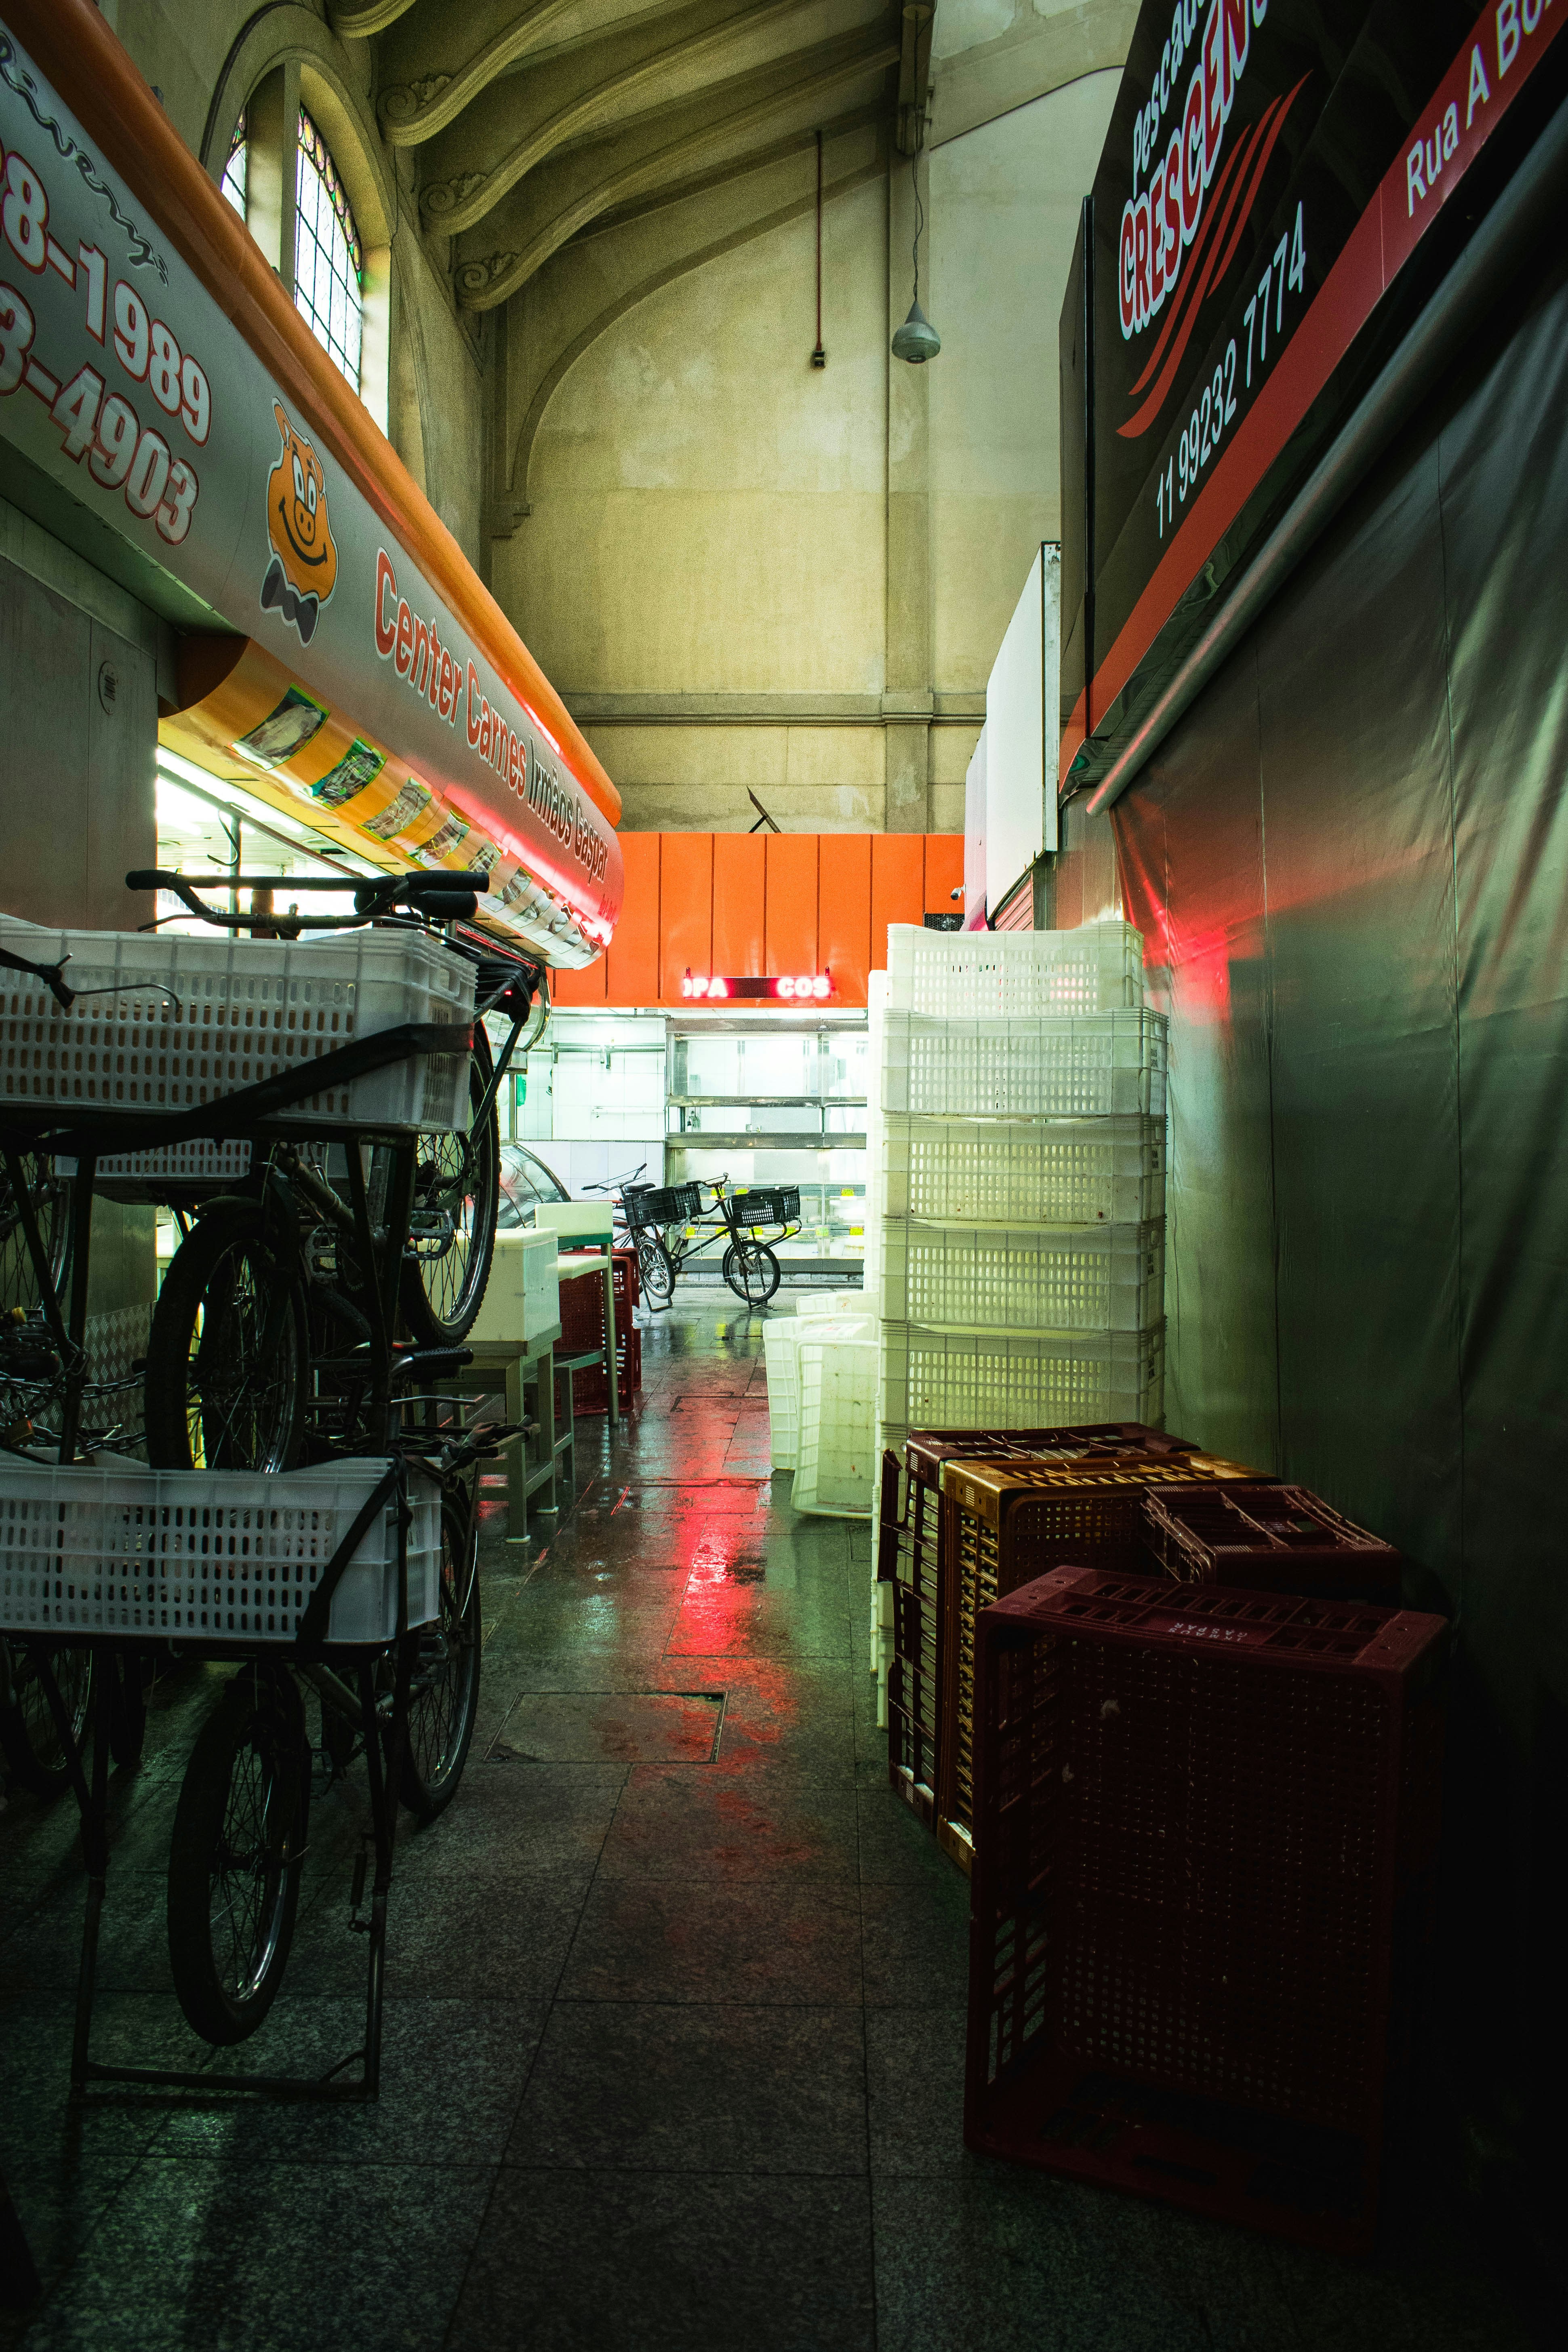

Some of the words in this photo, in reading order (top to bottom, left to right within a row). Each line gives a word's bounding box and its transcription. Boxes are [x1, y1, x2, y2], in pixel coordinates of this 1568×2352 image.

[1118, 0, 1268, 339] CRESCEN
[1406, 101, 1459, 218] Rua
[1466, 43, 1490, 130] A
[1496, 0, 1553, 80] Bo
[0, 137, 212, 447] 8-1989
[1156, 455, 1174, 539] 11
[1179, 338, 1237, 501] 99232
[1243, 200, 1306, 388] 7774
[374, 546, 463, 727] Center
[466, 657, 527, 800] Carnes
[527, 733, 574, 849] Irmãos
[574, 792, 609, 886] Gaspar
[777, 977, 830, 998] COS
